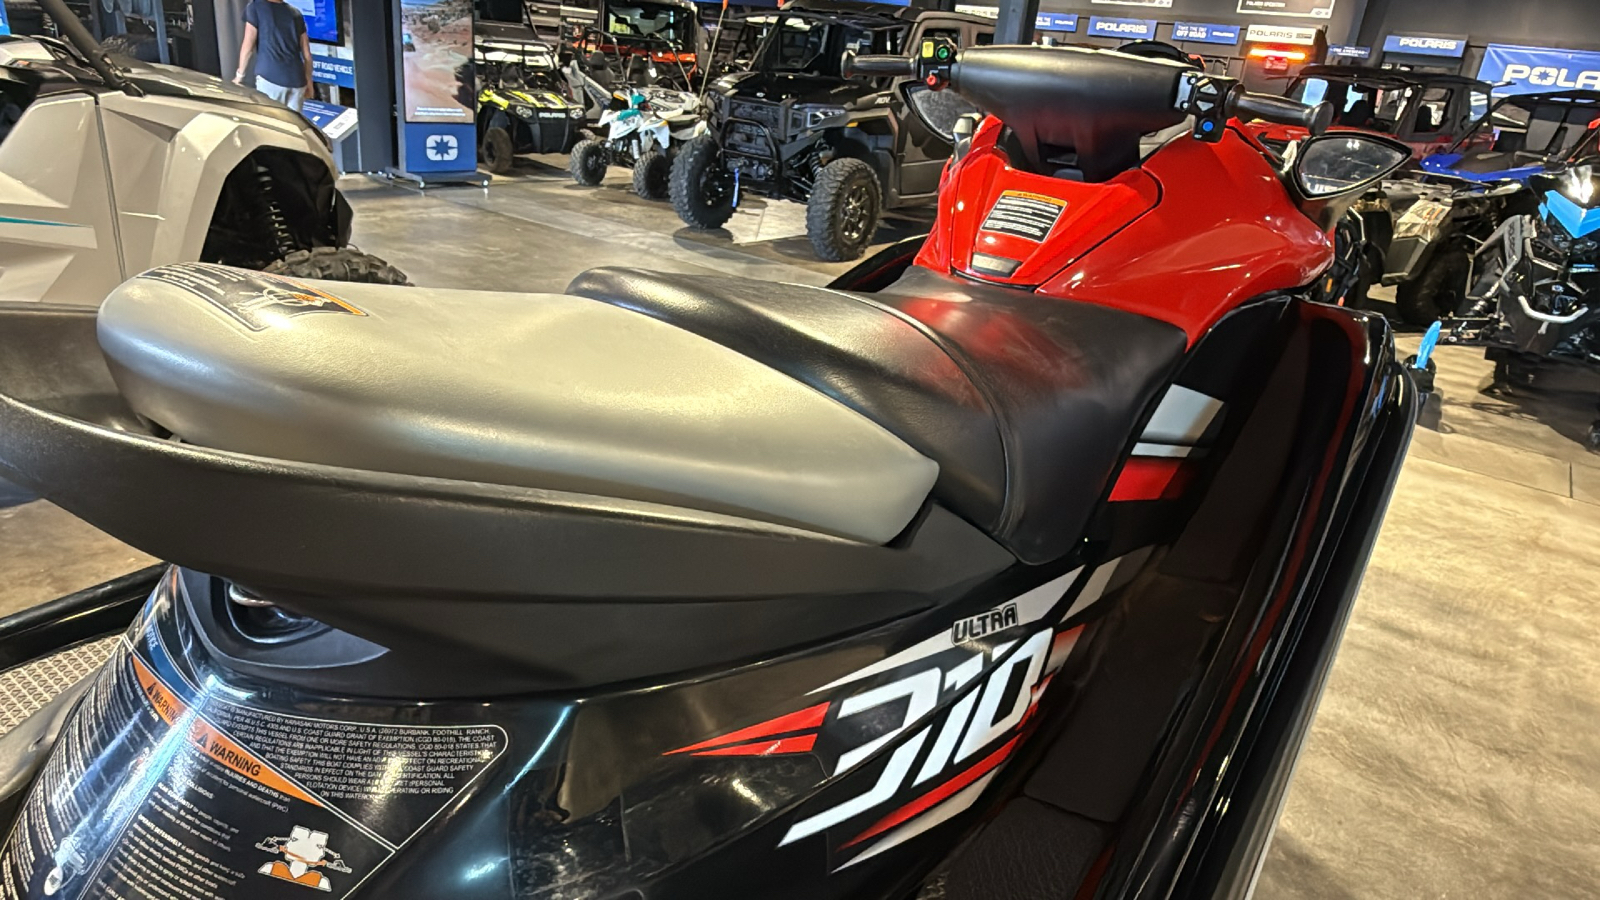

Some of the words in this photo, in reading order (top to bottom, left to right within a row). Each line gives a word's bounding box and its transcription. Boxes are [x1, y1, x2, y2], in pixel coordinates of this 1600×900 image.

[1096, 22, 1147, 34] POLARIS
[1249, 30, 1292, 39] POLARIS
[1400, 37, 1457, 50] POLARIS
[334, 65, 353, 74] VEHICLE
[954, 604, 1016, 644] ULTRA
[236, 708, 276, 722] MANUFACTURED
[285, 718, 313, 728] KAWASAKI
[314, 721, 338, 730] MOTORS
[268, 730, 288, 738] VESSEL
[233, 730, 254, 740] CERTAIN
[255, 736, 292, 746] REGULATIONS
[305, 744, 345, 753] INAPPLICABLE
[210, 740, 262, 776] WARNING
[265, 753, 289, 762] BOATING
[286, 749, 318, 758] EXEMPTION
[280, 763, 314, 772] STANDARDS
[294, 772, 322, 781] PERSONS
[225, 768, 246, 784] INJURIES
[257, 784, 279, 798] DEATHS
[306, 781, 338, 790] FLOTATION
